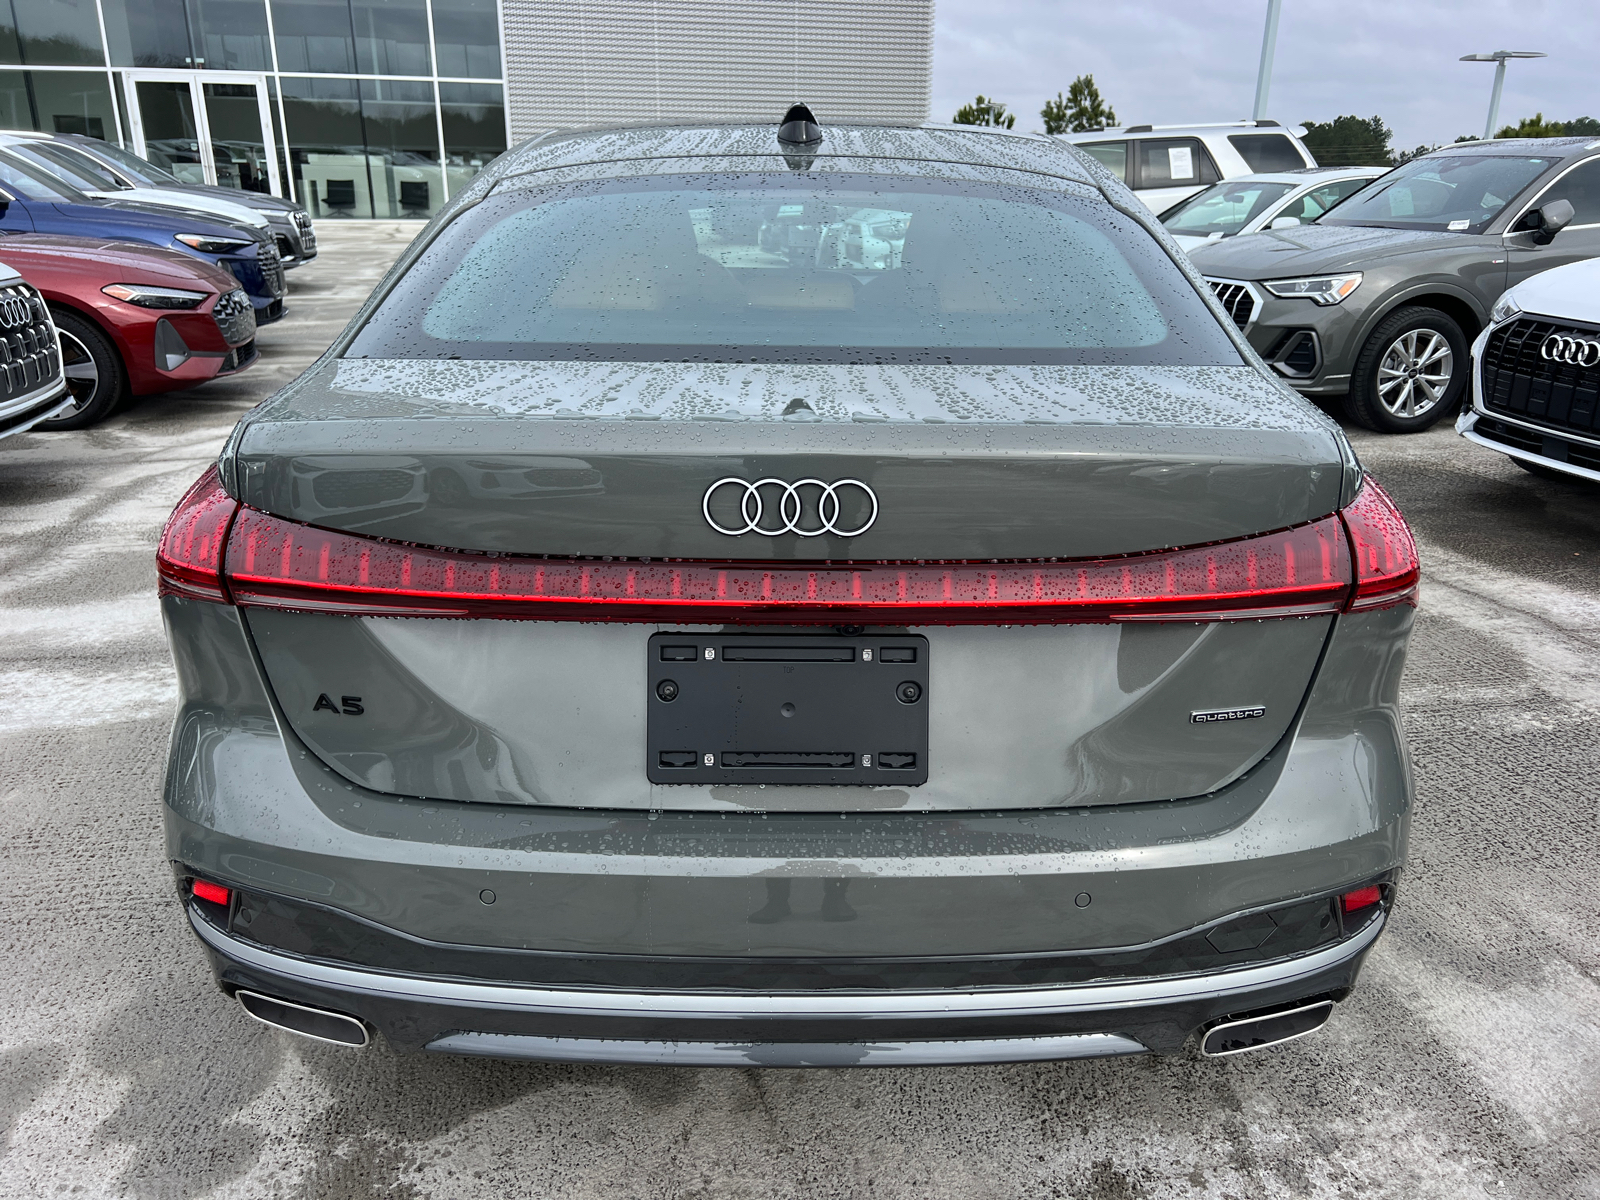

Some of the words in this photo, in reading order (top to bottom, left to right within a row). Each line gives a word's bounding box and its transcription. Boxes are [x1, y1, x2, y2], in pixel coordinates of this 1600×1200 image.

[783, 665, 795, 674] TOP
[312, 693, 365, 716] A5
[1195, 709, 1264, 723] quattro
